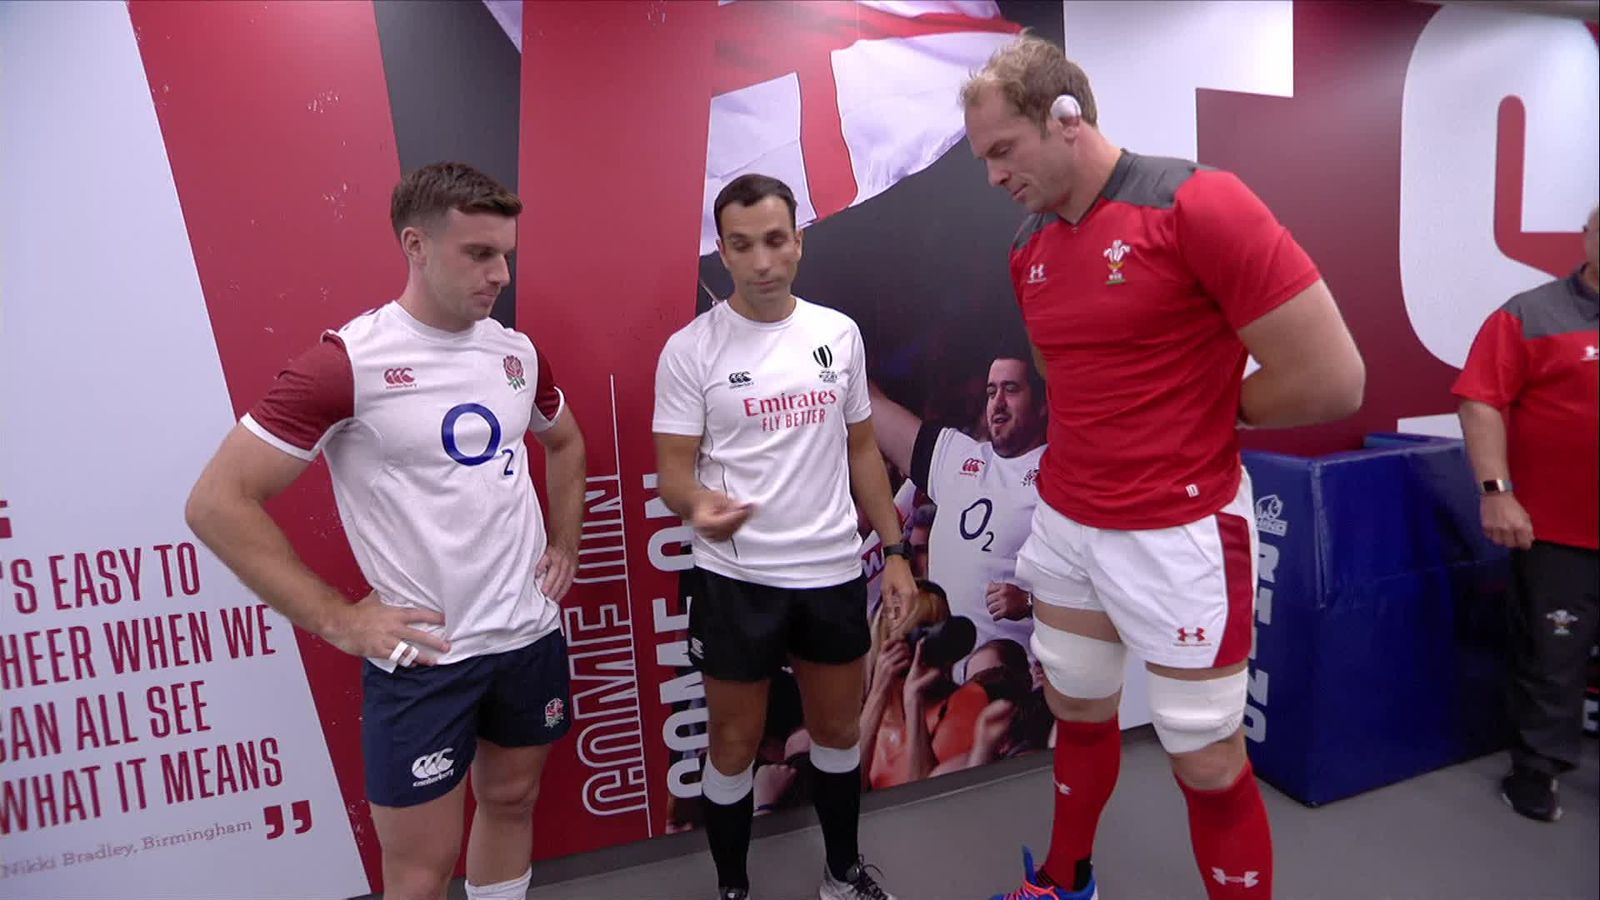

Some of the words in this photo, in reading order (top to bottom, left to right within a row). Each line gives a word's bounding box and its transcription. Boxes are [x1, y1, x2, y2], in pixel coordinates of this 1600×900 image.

[743, 389, 837, 417] Emirates
[761, 414, 781, 432] FLY
[48, 546, 141, 611] EASY
[153, 541, 201, 598] TO
[103, 611, 213, 675] WHEN
[219, 604, 277, 660] WE
[76, 691, 139, 751] ALL
[147, 680, 212, 739] SEE
[563, 602, 648, 816] COME
[0, 765, 101, 836] WHAT
[115, 758, 147, 813] IT
[160, 737, 283, 805] MEANS
[62, 843, 138, 867] Bradley,
[142, 820, 253, 850] Birmingham
